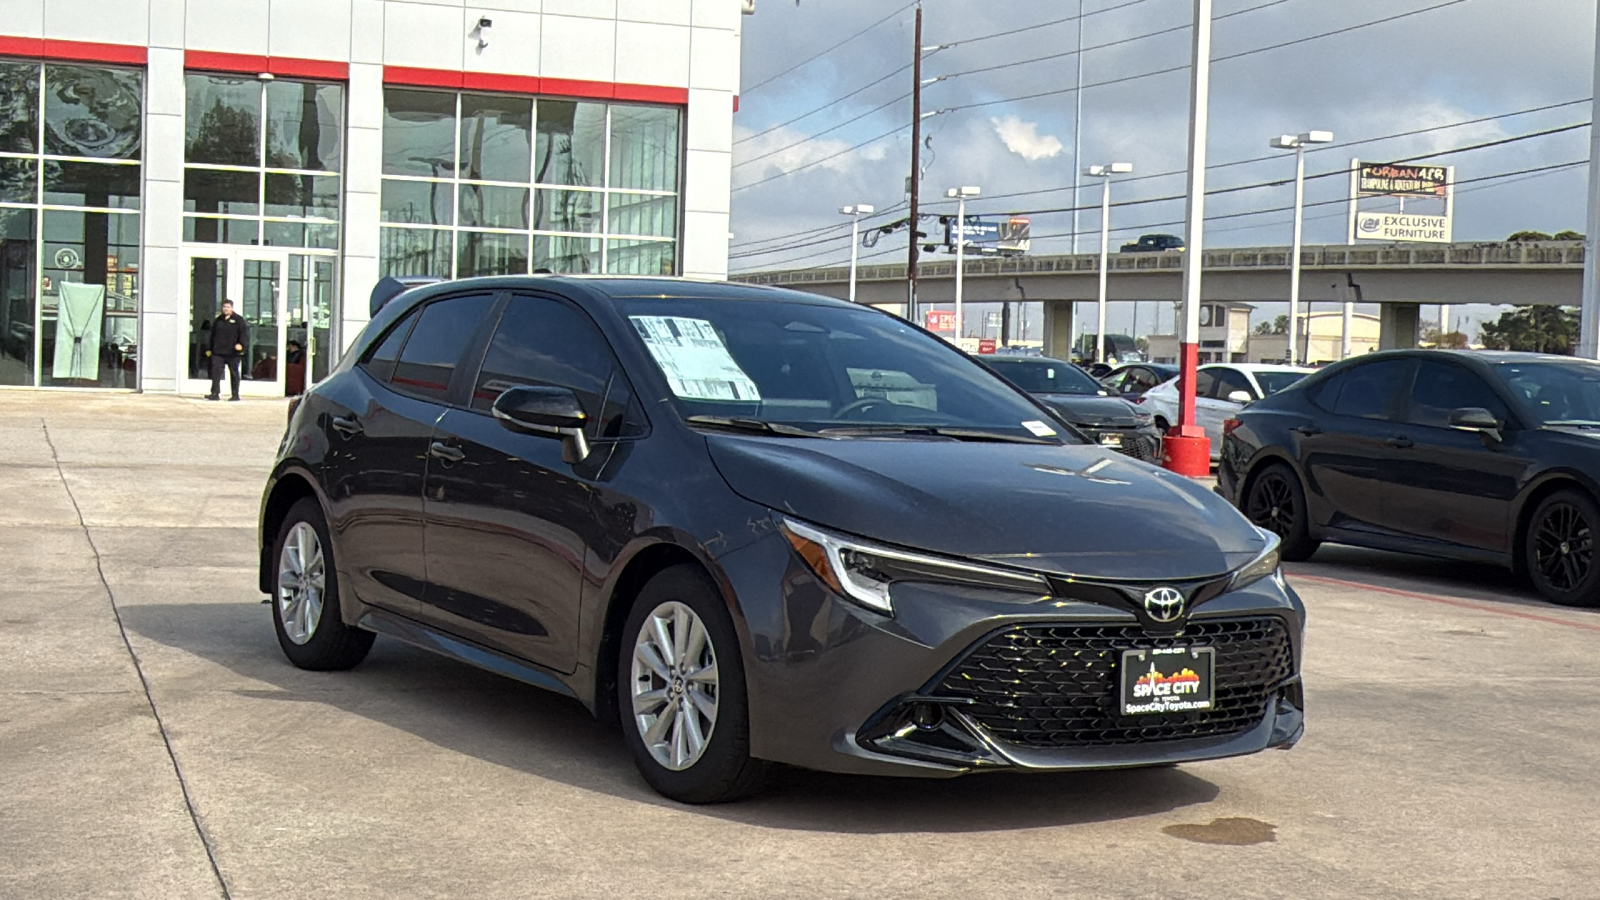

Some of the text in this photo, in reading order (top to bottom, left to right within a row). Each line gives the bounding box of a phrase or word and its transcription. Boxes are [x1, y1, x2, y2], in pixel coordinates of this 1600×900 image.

[1371, 166, 1418, 179] URBAN
[1384, 216, 1445, 228] EXCLUSIVE
[1384, 227, 1445, 239] FURNITURE
[1133, 682, 1200, 697] SPACE CITY
[1126, 701, 1210, 713] SpaceCityToyota.com
